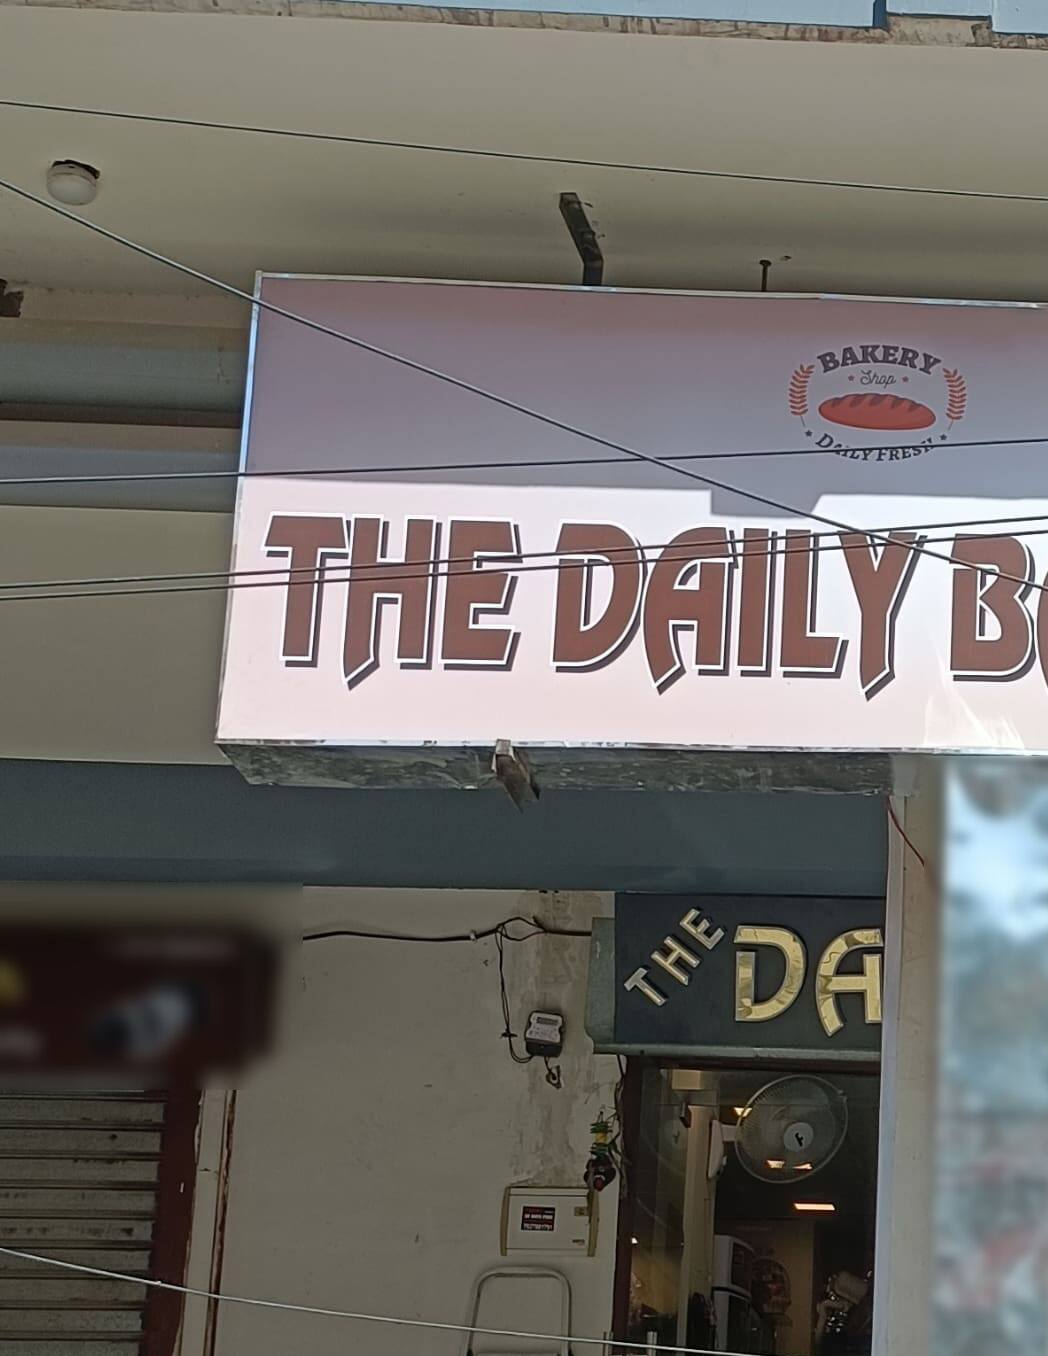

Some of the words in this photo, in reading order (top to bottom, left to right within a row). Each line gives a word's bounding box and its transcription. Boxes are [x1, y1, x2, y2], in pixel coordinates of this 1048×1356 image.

[816, 344, 942, 375] BAKERY
[860, 369, 897, 389] Shop
[815, 433, 873, 461] DAILY
[263, 512, 522, 691] THE
[550, 520, 928, 702] DAILY
[623, 907, 725, 1007] THE
